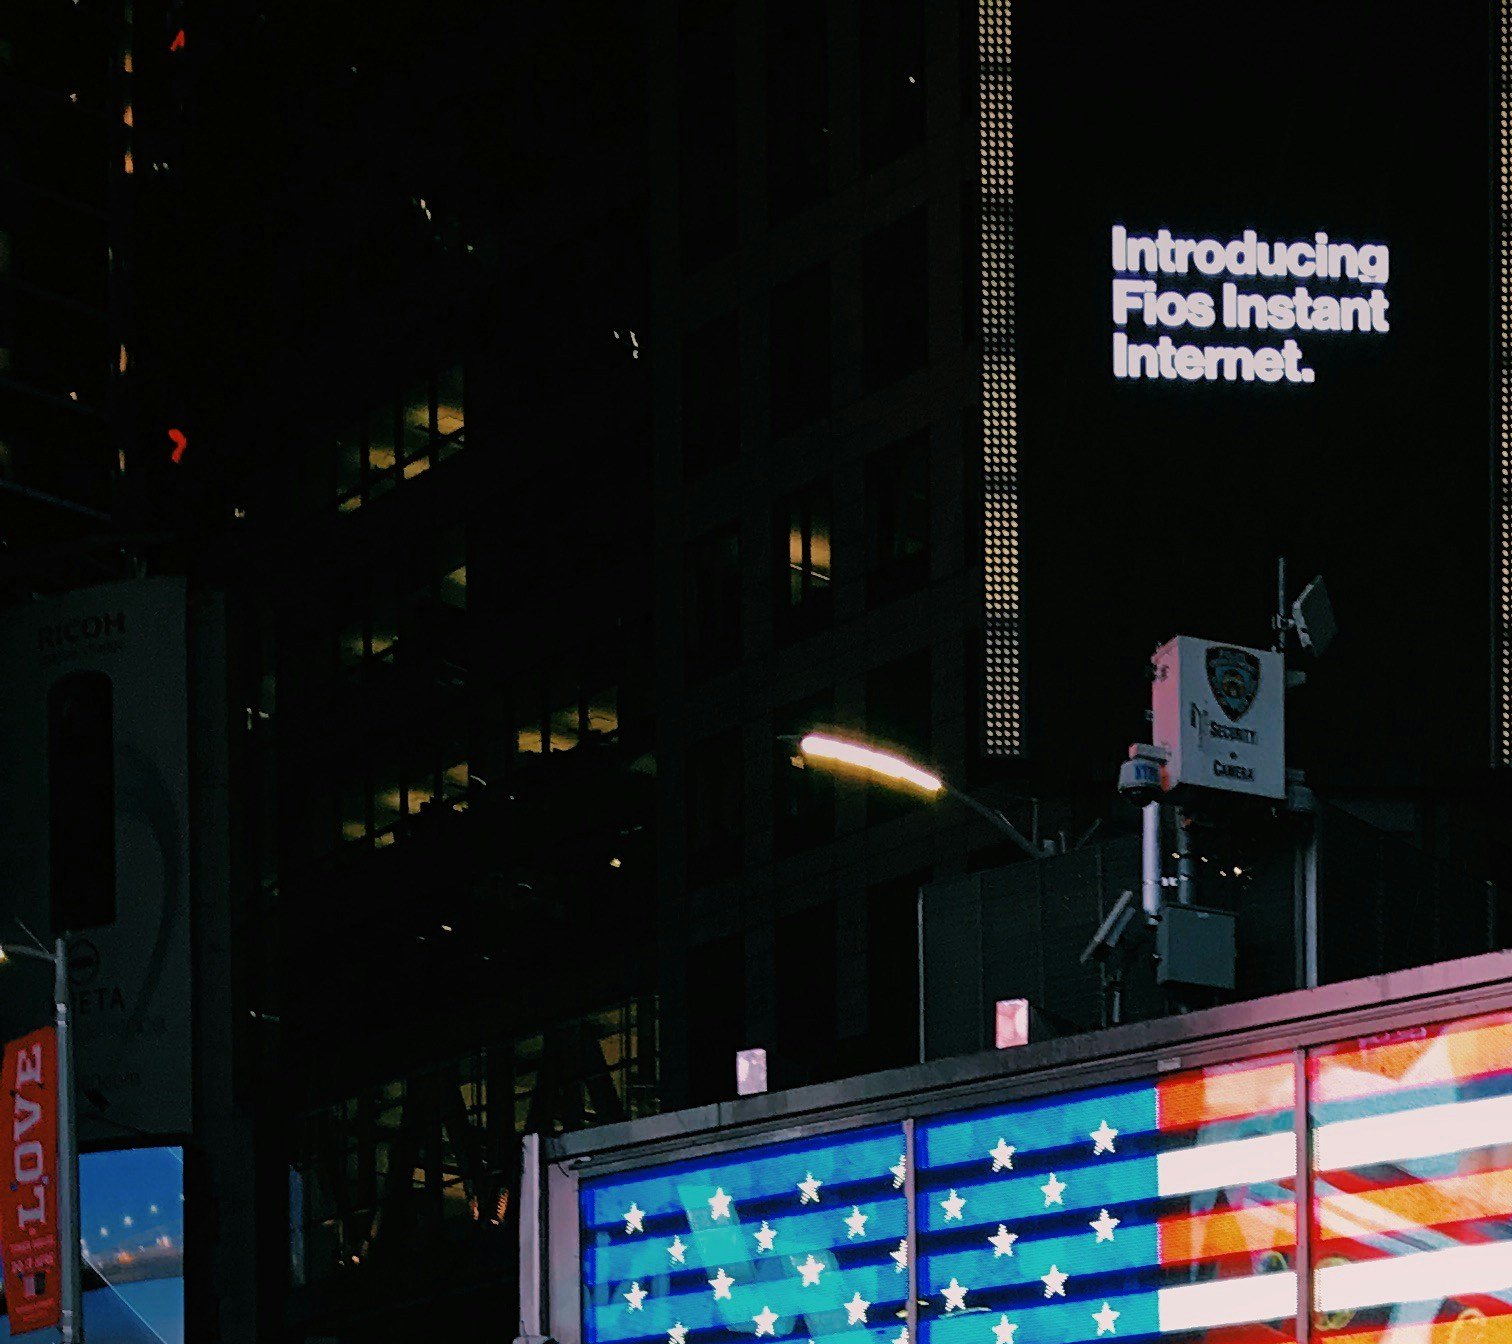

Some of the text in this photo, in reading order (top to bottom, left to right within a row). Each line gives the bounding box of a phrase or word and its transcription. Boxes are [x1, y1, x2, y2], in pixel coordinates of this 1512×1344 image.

[1111, 224, 1390, 284] Introducing
[1112, 279, 1390, 333] Fios Instant
[1112, 331, 1315, 383] Internet.
[37, 610, 126, 651] RICOH
[1213, 759, 1255, 782] CAMERA
[13, 1043, 47, 1230] LOVE
